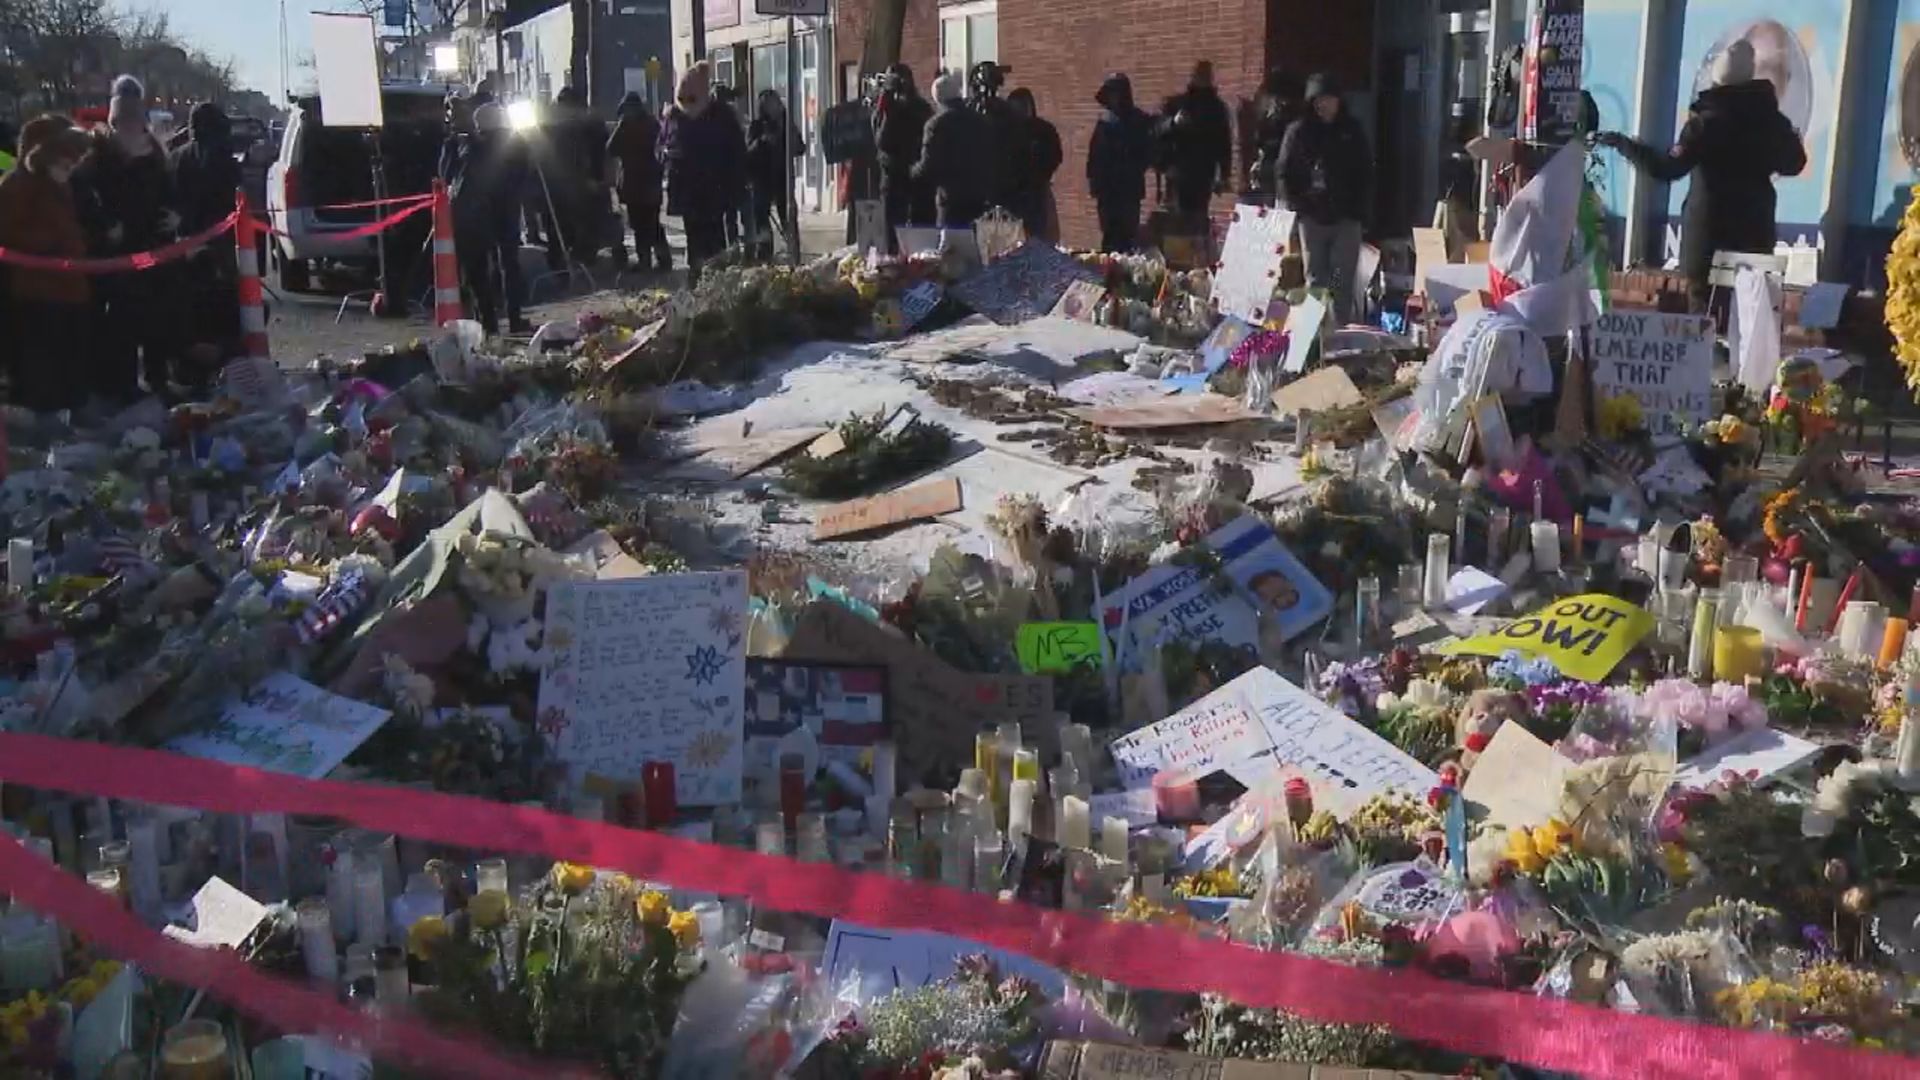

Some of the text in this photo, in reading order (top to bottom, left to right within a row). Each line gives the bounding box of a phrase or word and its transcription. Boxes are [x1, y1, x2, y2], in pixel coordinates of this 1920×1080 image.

[1597, 313, 1646, 337] ODAY
[1595, 337, 1689, 363] EMEMBE
[1613, 361, 1671, 385] THAT
[1131, 594, 1157, 611] VA
[1556, 602, 1627, 628] OUT
[1260, 697, 1326, 740] ALEX
[1099, 1050, 1176, 1077] MEMOR
